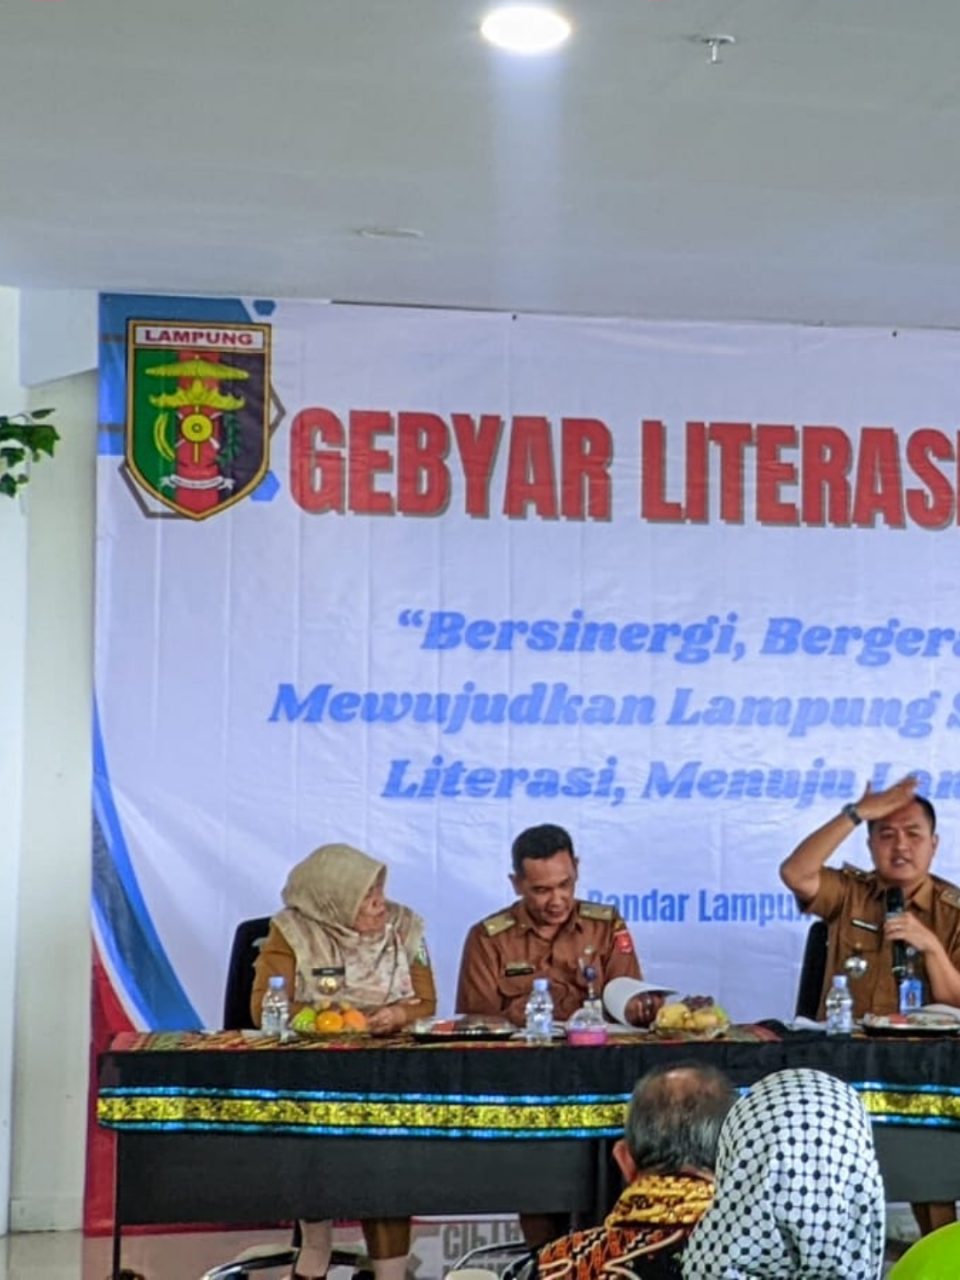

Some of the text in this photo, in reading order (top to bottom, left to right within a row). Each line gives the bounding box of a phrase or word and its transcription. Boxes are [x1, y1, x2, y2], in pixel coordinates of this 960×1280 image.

[145, 330, 253, 345] LAMPUNG
[290, 407, 612, 521] GEBYAR
[269, 683, 655, 736] Mewujudkan
[667, 689, 942, 738] Lampung
[381, 758, 626, 808] Literasi,
[641, 758, 855, 810] Menuju
